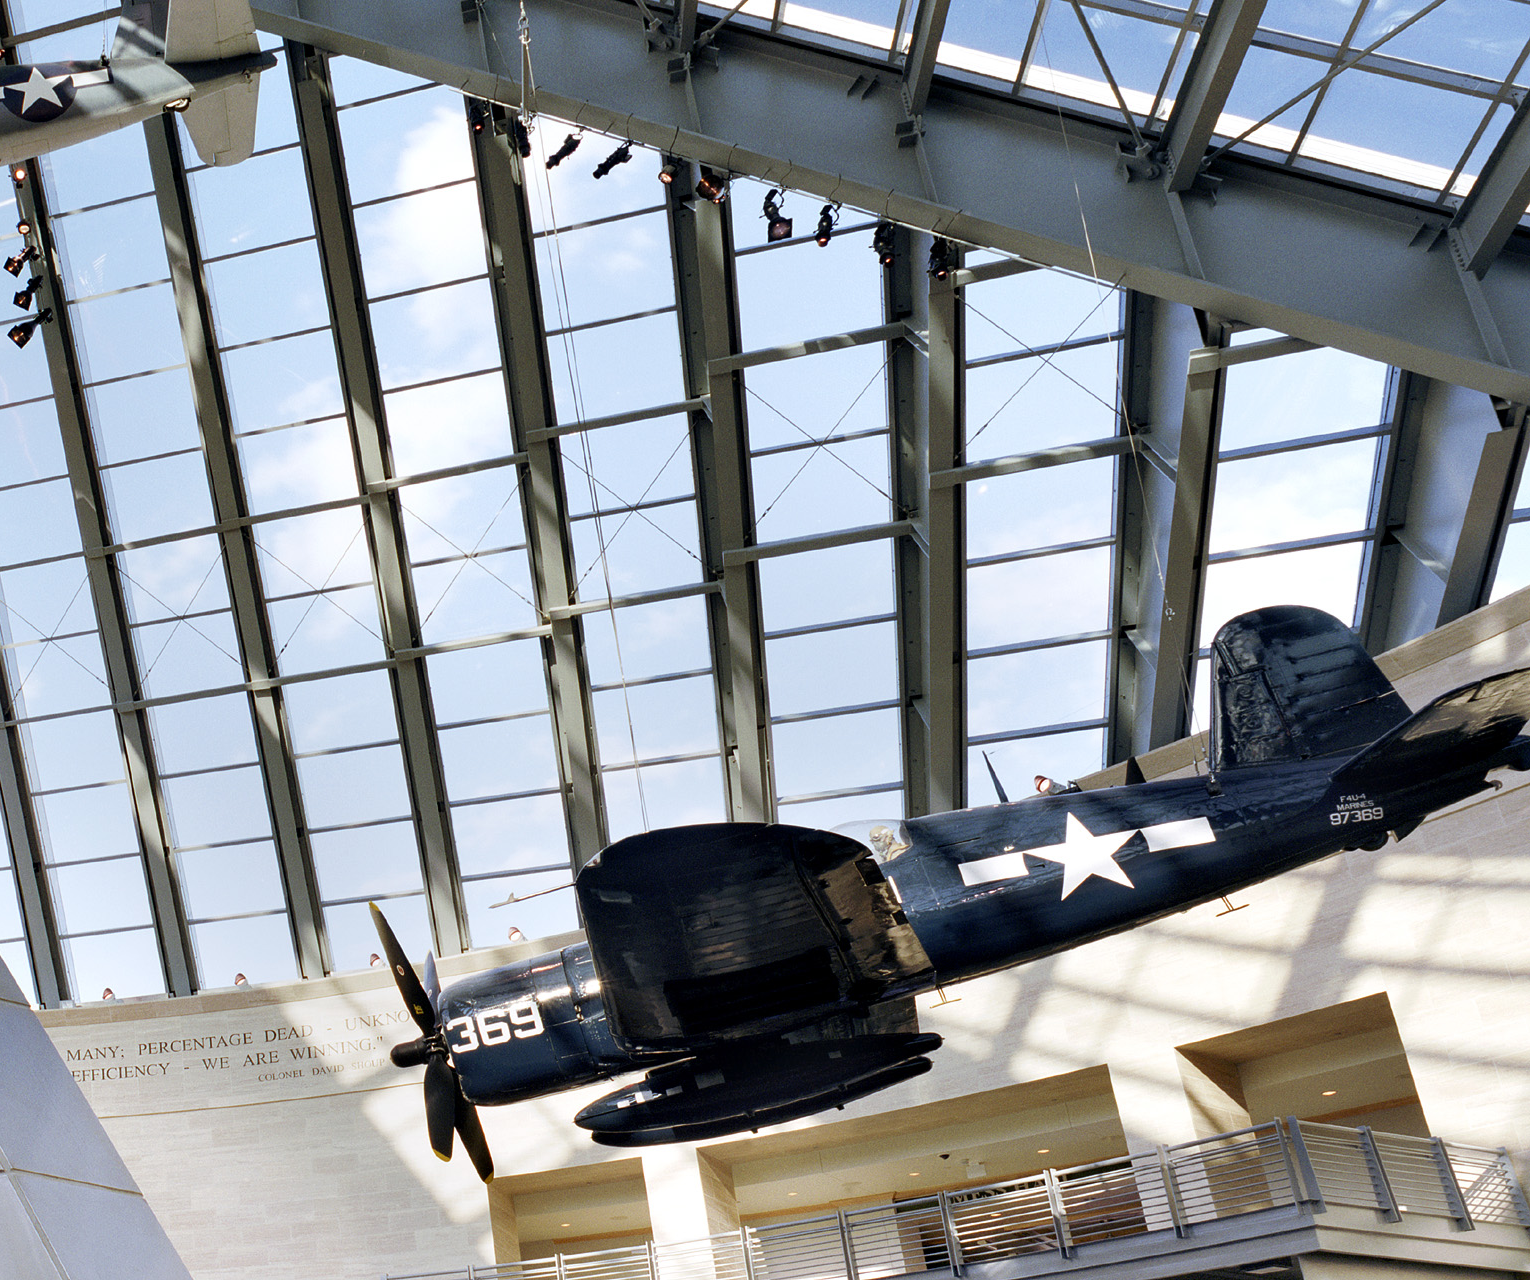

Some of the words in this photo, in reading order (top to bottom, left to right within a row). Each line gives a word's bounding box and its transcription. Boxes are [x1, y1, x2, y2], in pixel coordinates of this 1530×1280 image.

[1336, 800, 1375, 811] MARINES
[1340, 793, 1366, 803] F4U-4
[1330, 807, 1384, 826] 97369
[66, 1046, 125, 1062] MANY;
[138, 1032, 254, 1056] PERCENTAGE
[264, 1025, 313, 1043] DEAD
[345, 1009, 410, 1031] UNKNO
[446, 1001, 545, 1054] 369
[71, 1062, 170, 1083] EFFICIENCY
[202, 1056, 230, 1071] WE
[243, 1050, 280, 1067] ARE
[290, 1036, 383, 1061] WINNING."
[258, 1070, 304, 1082] COLONEL
[312, 1064, 345, 1076] DAVID
[352, 1059, 386, 1070] SHOUP
